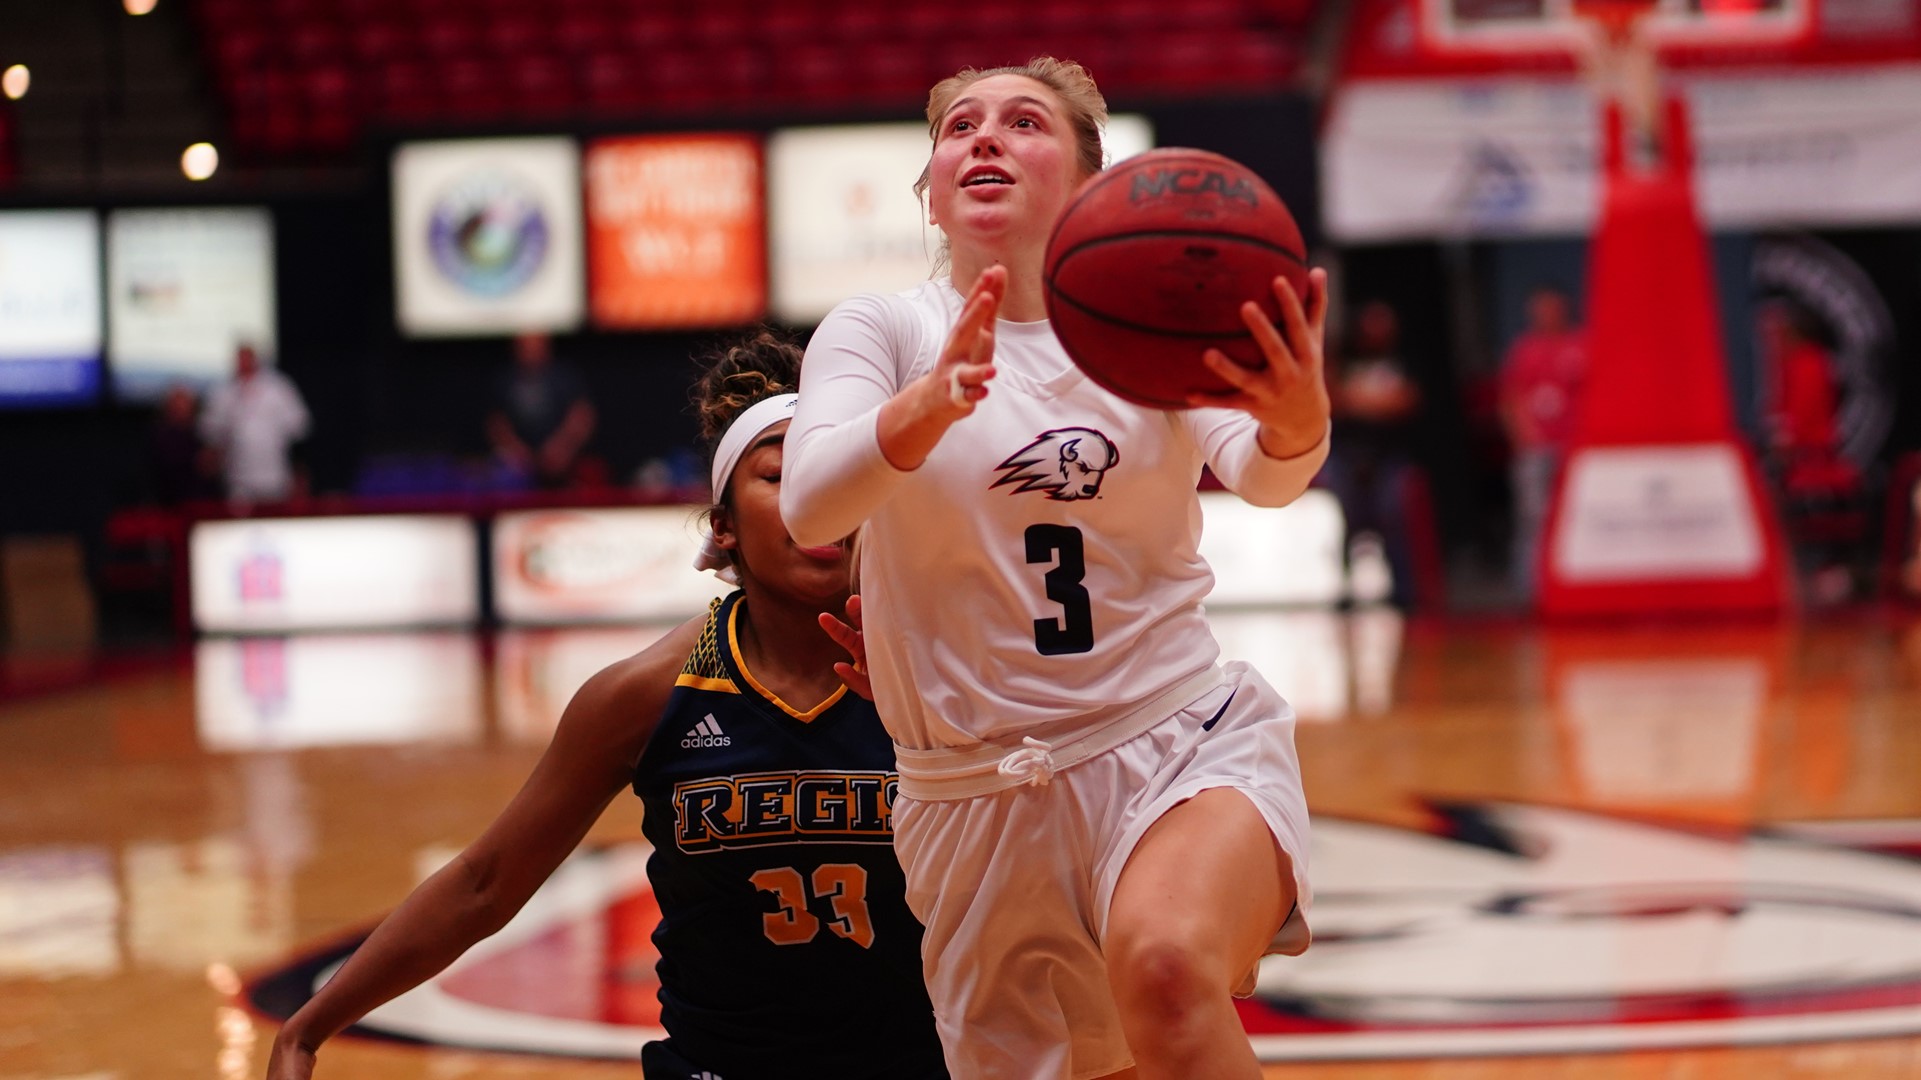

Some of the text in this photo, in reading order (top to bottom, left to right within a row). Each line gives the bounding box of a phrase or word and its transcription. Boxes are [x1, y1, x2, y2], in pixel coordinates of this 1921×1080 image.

[1129, 168, 1260, 208] NCAA
[1024, 523, 1094, 656] 3
[680, 734, 731, 749] adidas
[748, 863, 875, 950] 33
